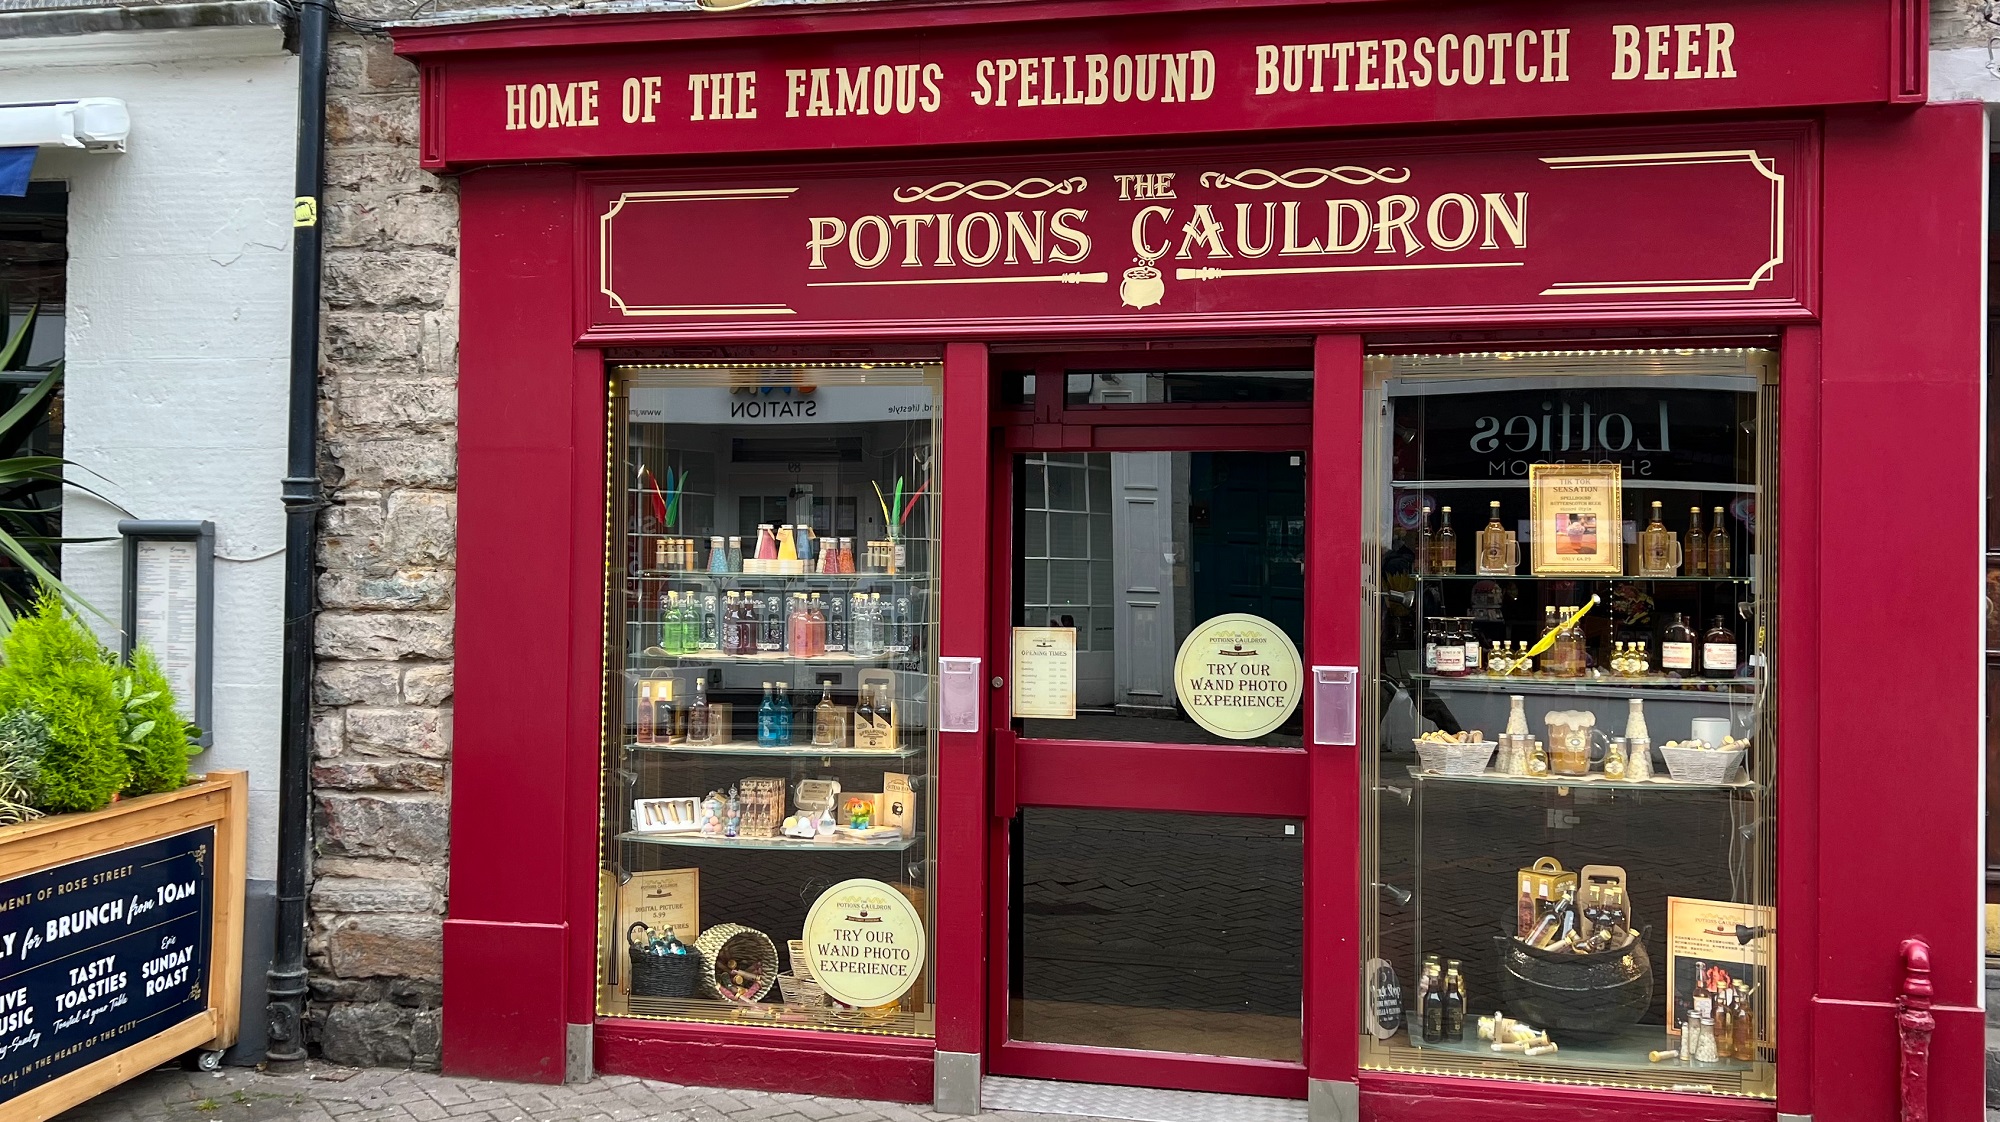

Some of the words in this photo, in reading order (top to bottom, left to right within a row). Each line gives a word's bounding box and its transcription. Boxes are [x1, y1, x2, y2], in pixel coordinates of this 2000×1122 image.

[506, 80, 599, 130] HOME
[622, 76, 662, 124] OF
[688, 70, 757, 121] THE
[785, 63, 944, 118] FAMOUS
[970, 50, 1216, 107] SPELLBOUND
[1255, 28, 1570, 95] BUTTERSCOTCH
[1611, 22, 1737, 80] BEER
[1113, 172, 1178, 201] THE
[805, 208, 1091, 270] POTIONS
[1131, 191, 1529, 262] CAULDRON
[1206, 661, 1238, 676] TRY
[1240, 663, 1270, 676] OUR
[1190, 676, 1234, 691] WAND
[1239, 680, 1288, 692] PHOTO
[1193, 694, 1285, 708] EXPERIENCE
[37, 887, 53, 901] OF
[58, 877, 88, 896] ROSE
[92, 865, 134, 885] STREET
[21, 926, 43, 960] for
[46, 899, 124, 943] BRUNCH
[126, 894, 156, 925] from
[157, 880, 196, 906] 10AM
[860, 903, 892, 911] CAULDRON
[161, 934, 178, 950] Epic
[817, 942, 859, 957] WAND
[864, 946, 910, 960] PHOTO
[833, 928, 863, 941] TRY
[866, 930, 894, 944] OUR
[69, 955, 116, 987] TASTY
[142, 945, 194, 979] SUNDAY
[820, 959, 908, 977] EXPERIENCE
[55, 971, 128, 1012] TOASTIES
[146, 966, 189, 998] ROAST
[22, 1064, 33, 1076] IN
[35, 1055, 52, 1069] THE
[54, 1042, 83, 1061] HEART
[85, 1035, 98, 1048] OF
[100, 1028, 116, 1042] THE
[118, 1020, 137, 1034] CITY
